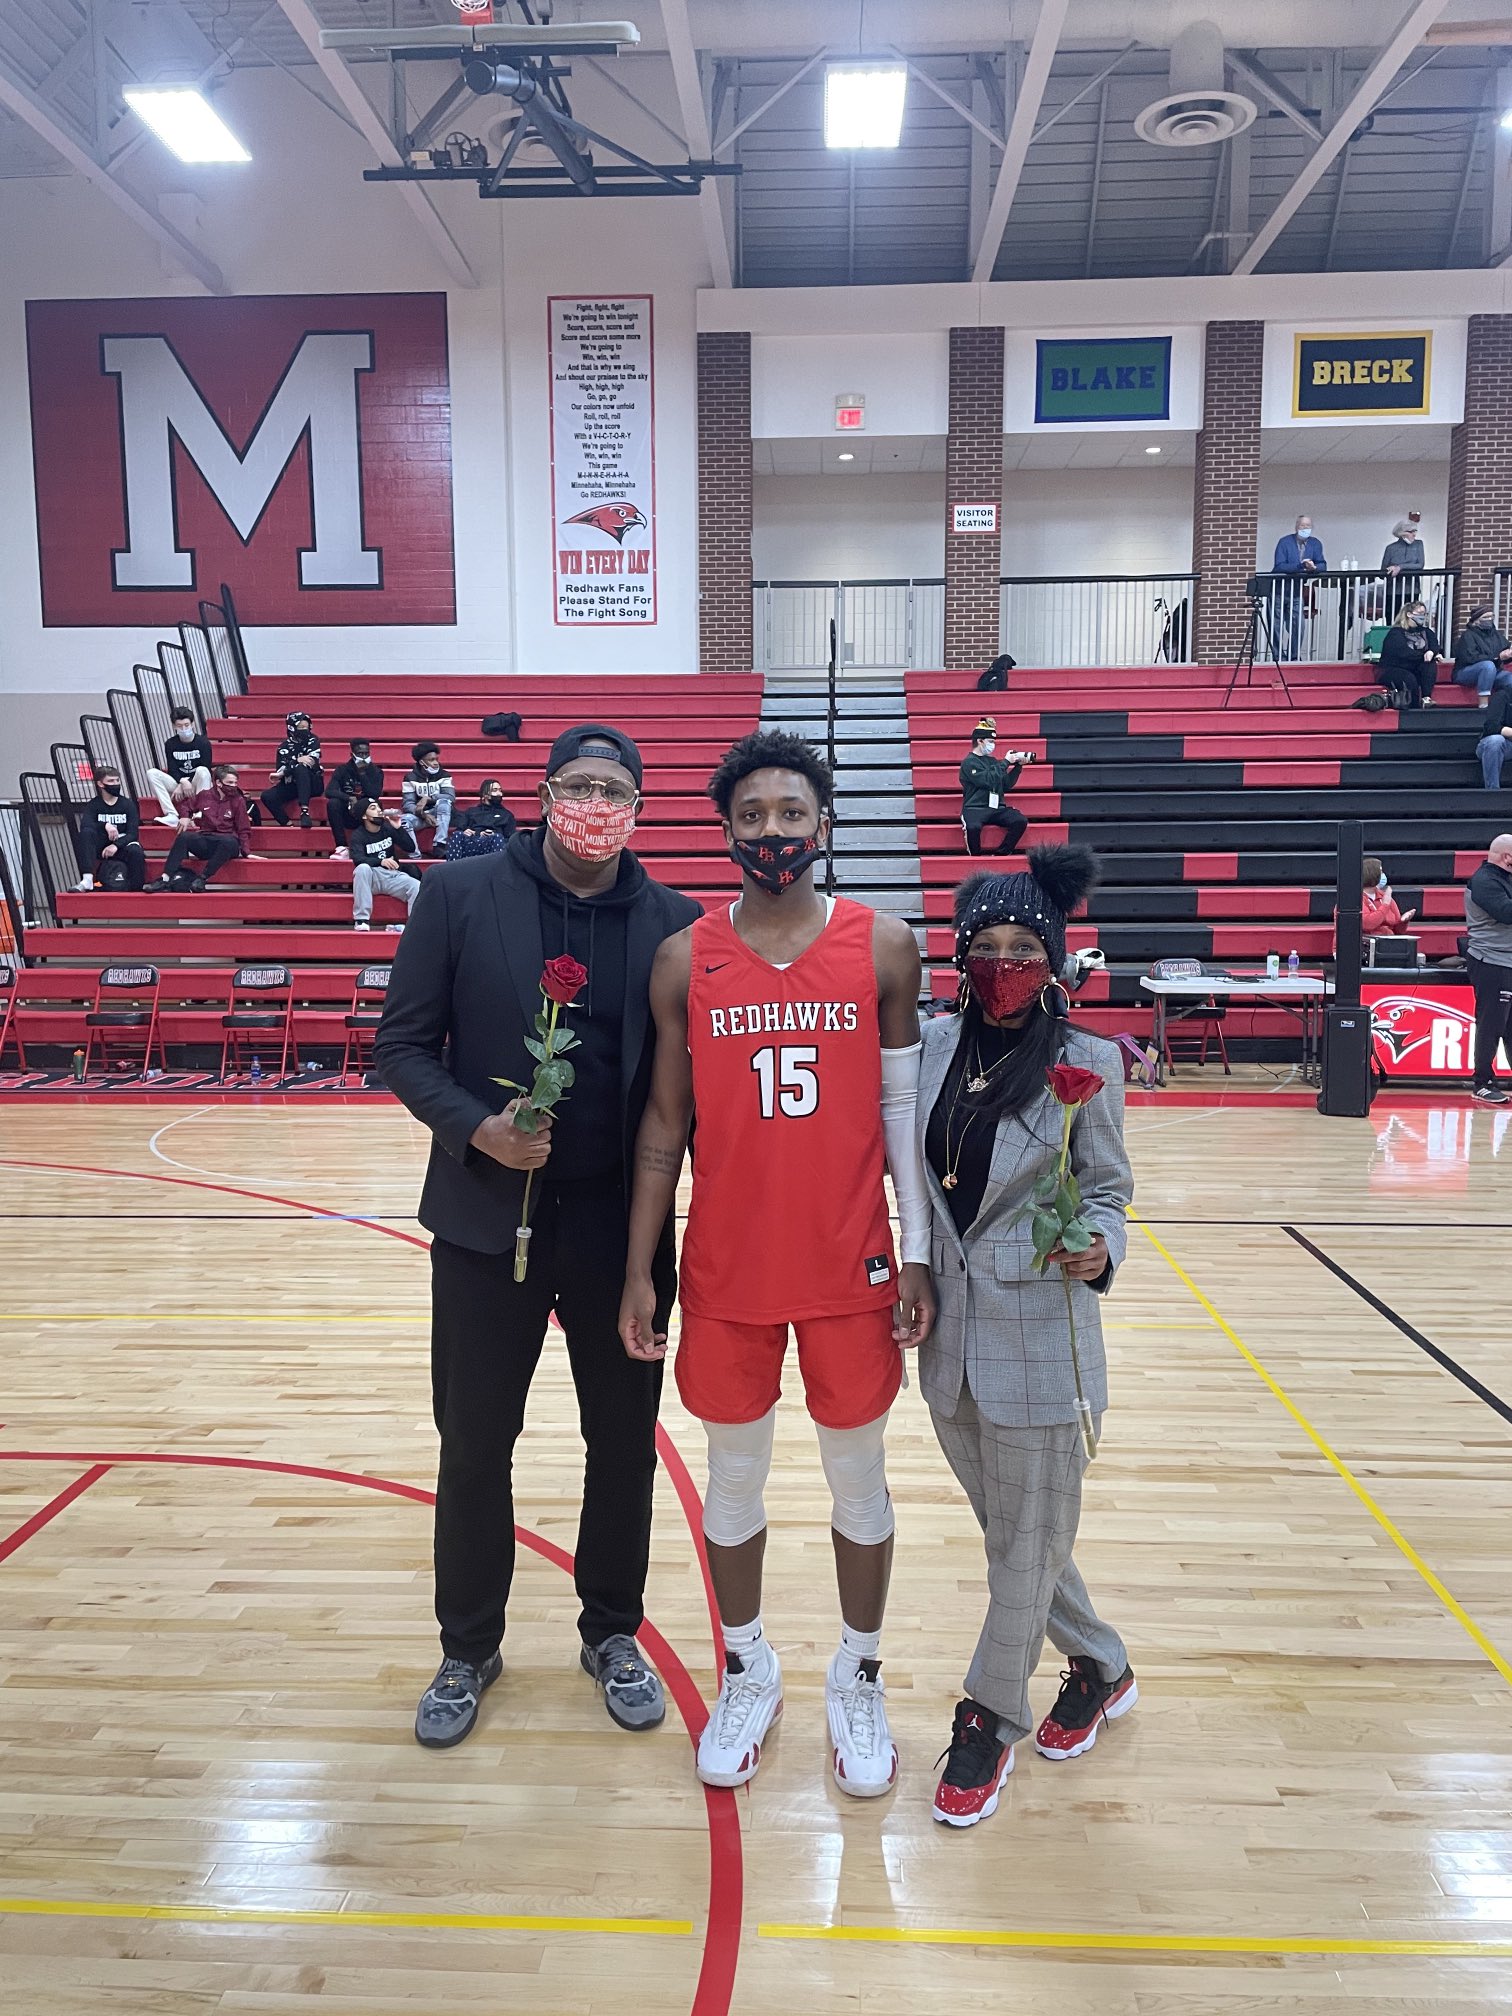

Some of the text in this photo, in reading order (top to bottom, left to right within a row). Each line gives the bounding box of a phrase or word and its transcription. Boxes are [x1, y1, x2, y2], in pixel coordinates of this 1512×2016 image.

[576, 304, 624, 312] Fight, fight, fight
[581, 314, 597, 322] going
[618, 314, 638, 322] tonight
[567, 323, 585, 331] Score,
[587, 323, 604, 331] score,
[598, 344, 614, 352] going
[601, 364, 611, 372] why
[623, 364, 635, 372] sing
[1312, 358, 1413, 385] BRECK
[598, 374, 618, 382] praises
[638, 374, 648, 382] sky
[1051, 365, 1157, 391] BLAKE
[599, 393, 607, 401] go,
[609, 393, 616, 401] go
[585, 423, 592, 431] Up
[600, 443, 616, 451] going
[100, 329, 384, 592] M
[602, 462, 617, 470] game
[571, 481, 603, 489] Minnehaha,
[956, 509, 994, 517] VISITOR
[956, 519, 994, 527] SEATING
[586, 550, 624, 574] EVERY
[628, 550, 650, 574] DAY
[566, 584, 644, 592] Redhawk Fans
[560, 596, 652, 604] Please Stand For
[588, 609, 615, 618] Fight
[619, 608, 647, 618] Song
[586, 814, 620, 827] MONEYATTI
[241, 969, 285, 985] REDHAWKS
[363, 970, 391, 986] REDHA
[709, 1002, 859, 1038] REDHAWKS
[750, 1045, 820, 1120] 15
[875, 1259, 882, 1268] L
